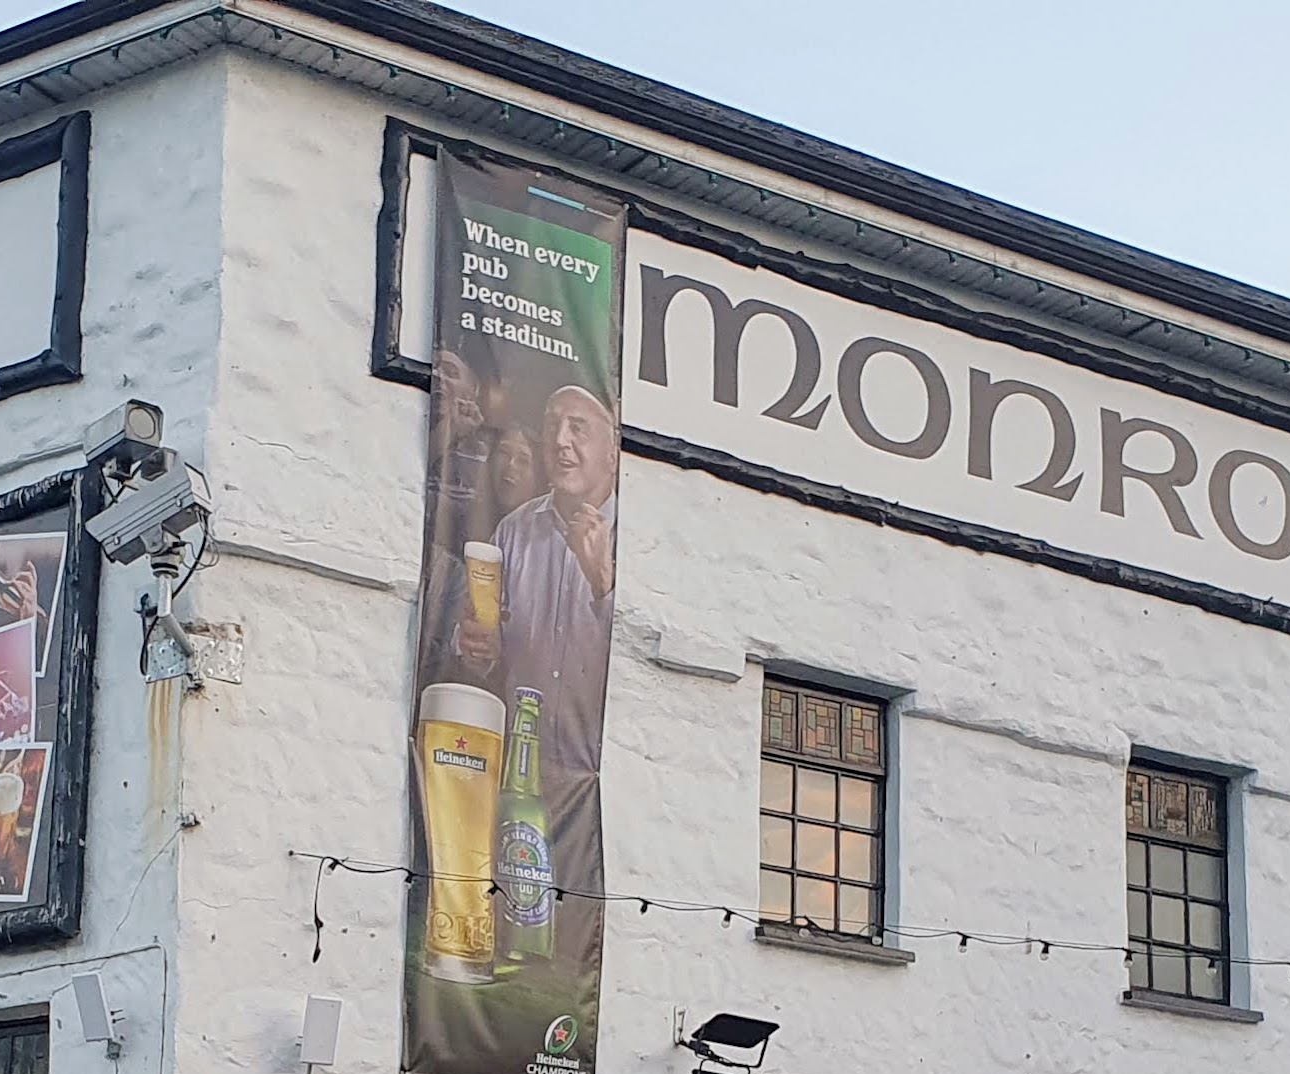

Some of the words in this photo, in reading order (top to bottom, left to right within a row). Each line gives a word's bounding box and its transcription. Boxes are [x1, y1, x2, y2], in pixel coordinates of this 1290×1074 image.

[463, 218, 530, 258] When
[535, 247, 599, 283] every
[462, 252, 508, 280] pub
[461, 278, 562, 326] becomes
[461, 311, 476, 330] a
[482, 315, 579, 362] stadium.
[436, 751, 484, 769] Heineken
[497, 862, 553, 882] Heineken
[536, 1052, 580, 1069] Heineken
